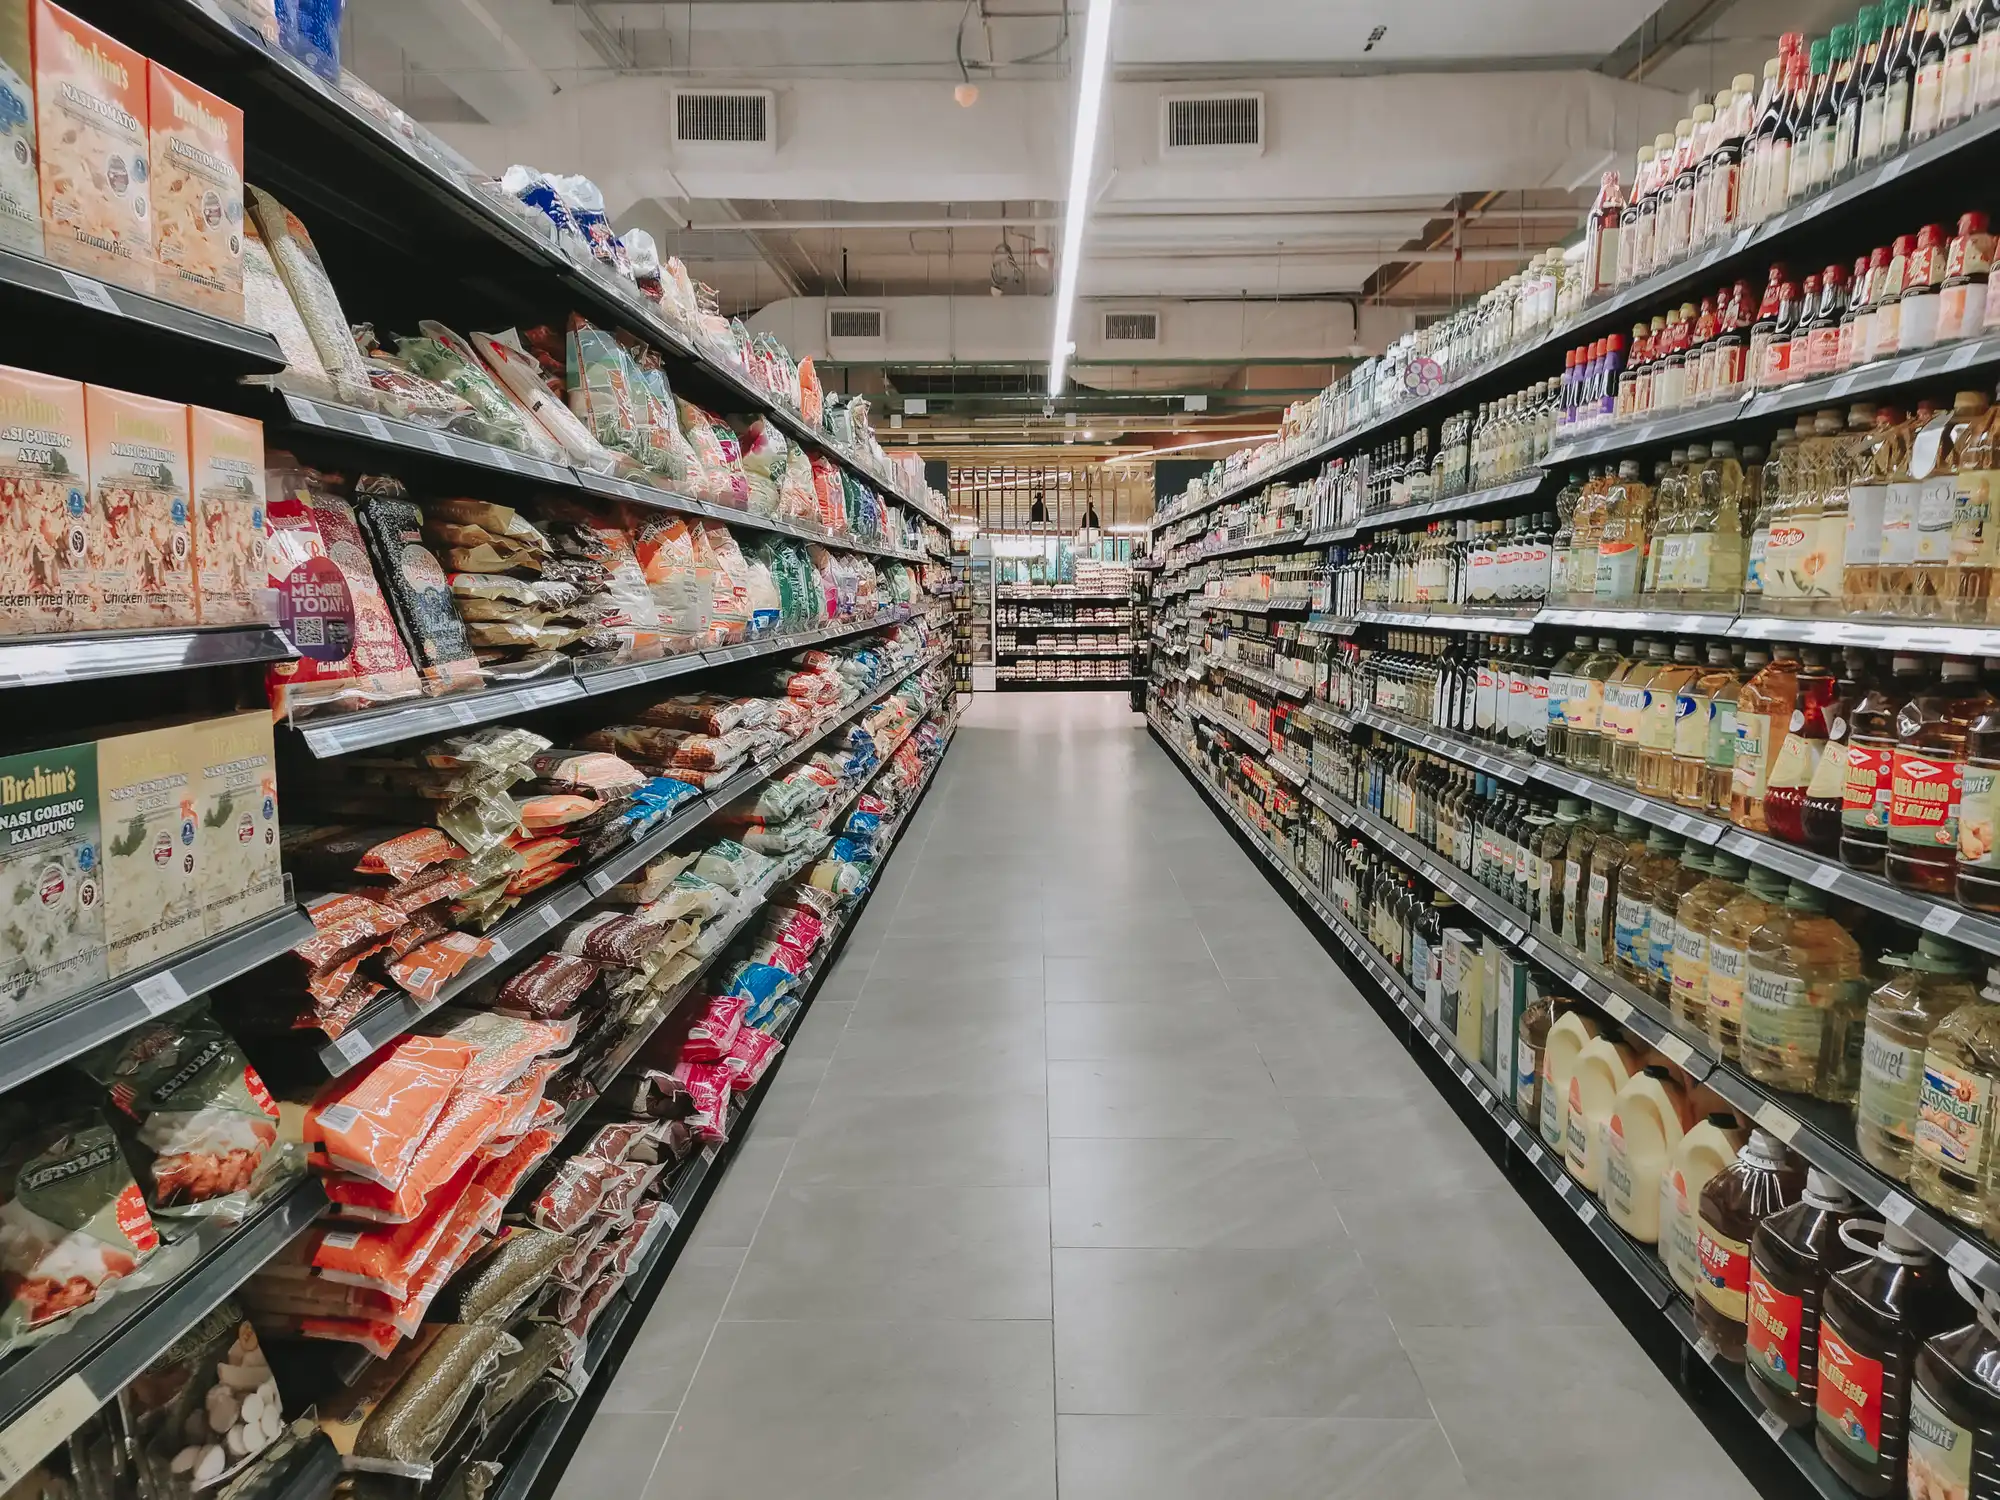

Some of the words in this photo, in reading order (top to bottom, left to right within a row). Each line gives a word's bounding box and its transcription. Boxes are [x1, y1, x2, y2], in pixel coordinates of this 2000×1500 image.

[92, 98, 137, 132] TOMATO
[26, 429, 72, 448] GORENG
[18, 448, 52, 465] AYAM
[133, 462, 160, 479] AYAM
[291, 572, 307, 584] BE
[311, 572, 319, 583] A
[35, 590, 63, 606] Fried
[66, 589, 89, 605] Rice
[103, 589, 143, 605] Chicken
[291, 583, 344, 597] MEMBER
[291, 597, 345, 613] TODAY!
[1, 765, 76, 806] Brahim's
[0, 810, 32, 830] NASI
[34, 798, 84, 821] GORENG
[11, 817, 76, 845] KAMPUNG
[206, 893, 239, 912] Mushroom
[109, 930, 150, 953] Mushroom
[151, 922, 159, 936] &
[160, 915, 186, 932] Cheese
[187, 908, 201, 920] Rice
[27, 1147, 113, 1190] KETUPAT
